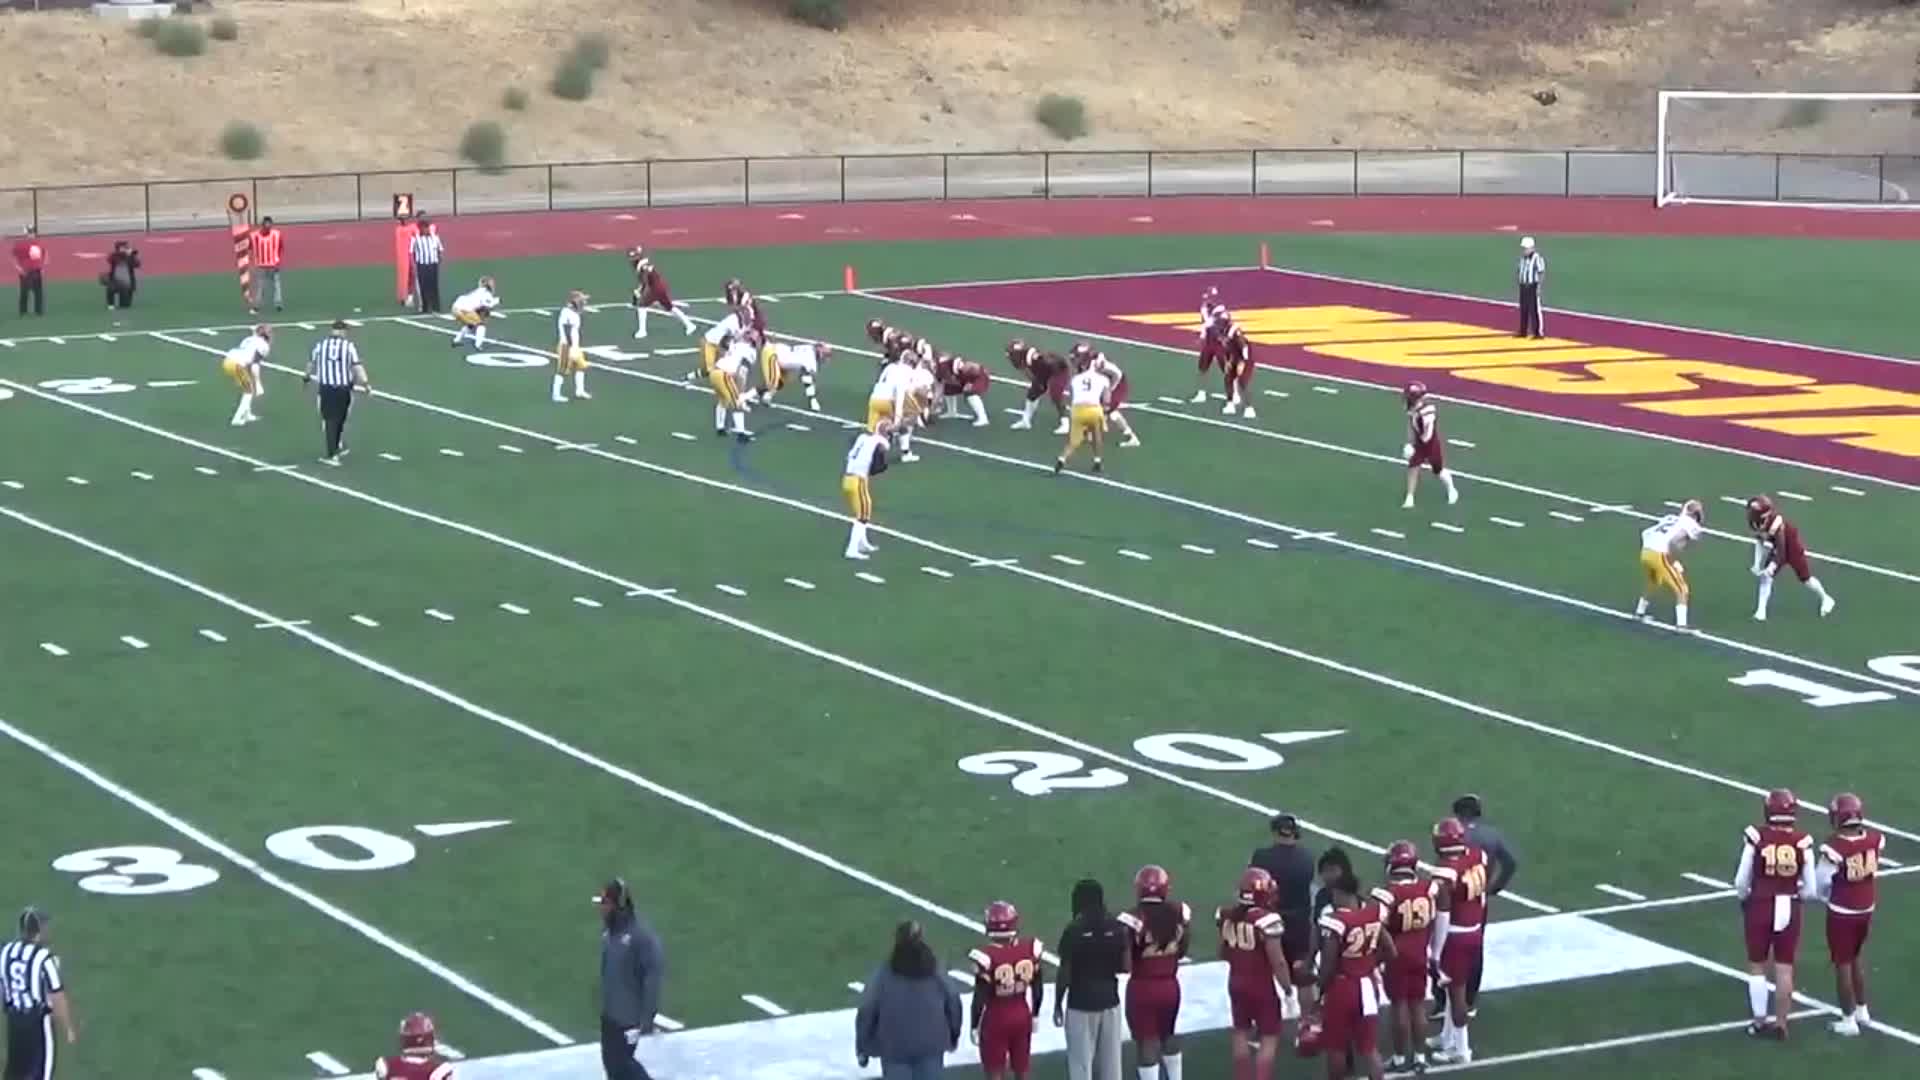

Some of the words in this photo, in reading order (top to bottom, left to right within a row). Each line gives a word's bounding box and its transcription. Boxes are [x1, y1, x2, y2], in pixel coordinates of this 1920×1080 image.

[396, 195, 410, 214] 2
[957, 732, 1285, 796] 20
[52, 824, 416, 895] 30
[1397, 896, 1431, 932] 13
[1342, 921, 1382, 958] 27
